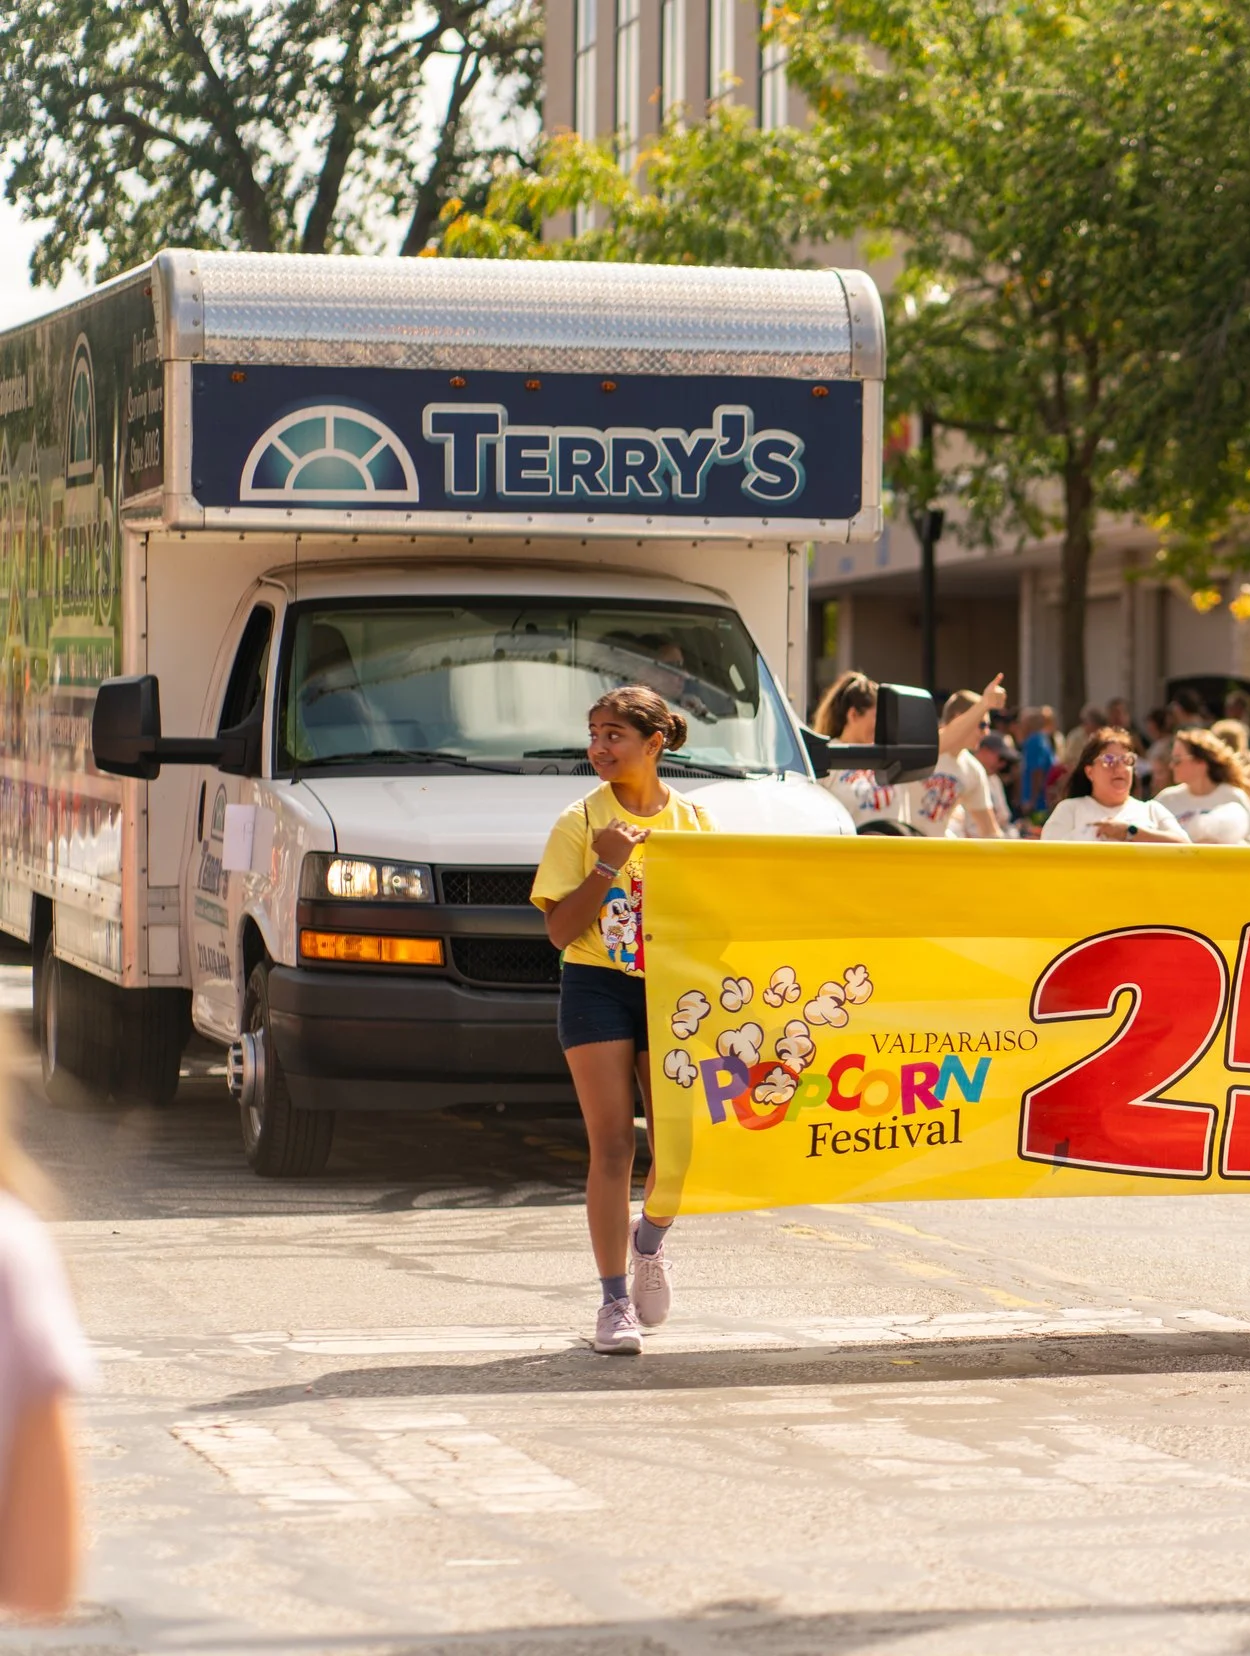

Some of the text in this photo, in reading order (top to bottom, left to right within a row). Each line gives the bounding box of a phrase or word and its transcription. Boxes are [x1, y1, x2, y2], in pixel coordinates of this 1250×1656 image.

[422, 402, 806, 503] TERRY'S
[870, 1029, 1038, 1054] VALPARAISO
[699, 1053, 993, 1132] POPCORN
[805, 1108, 963, 1158] Festival
